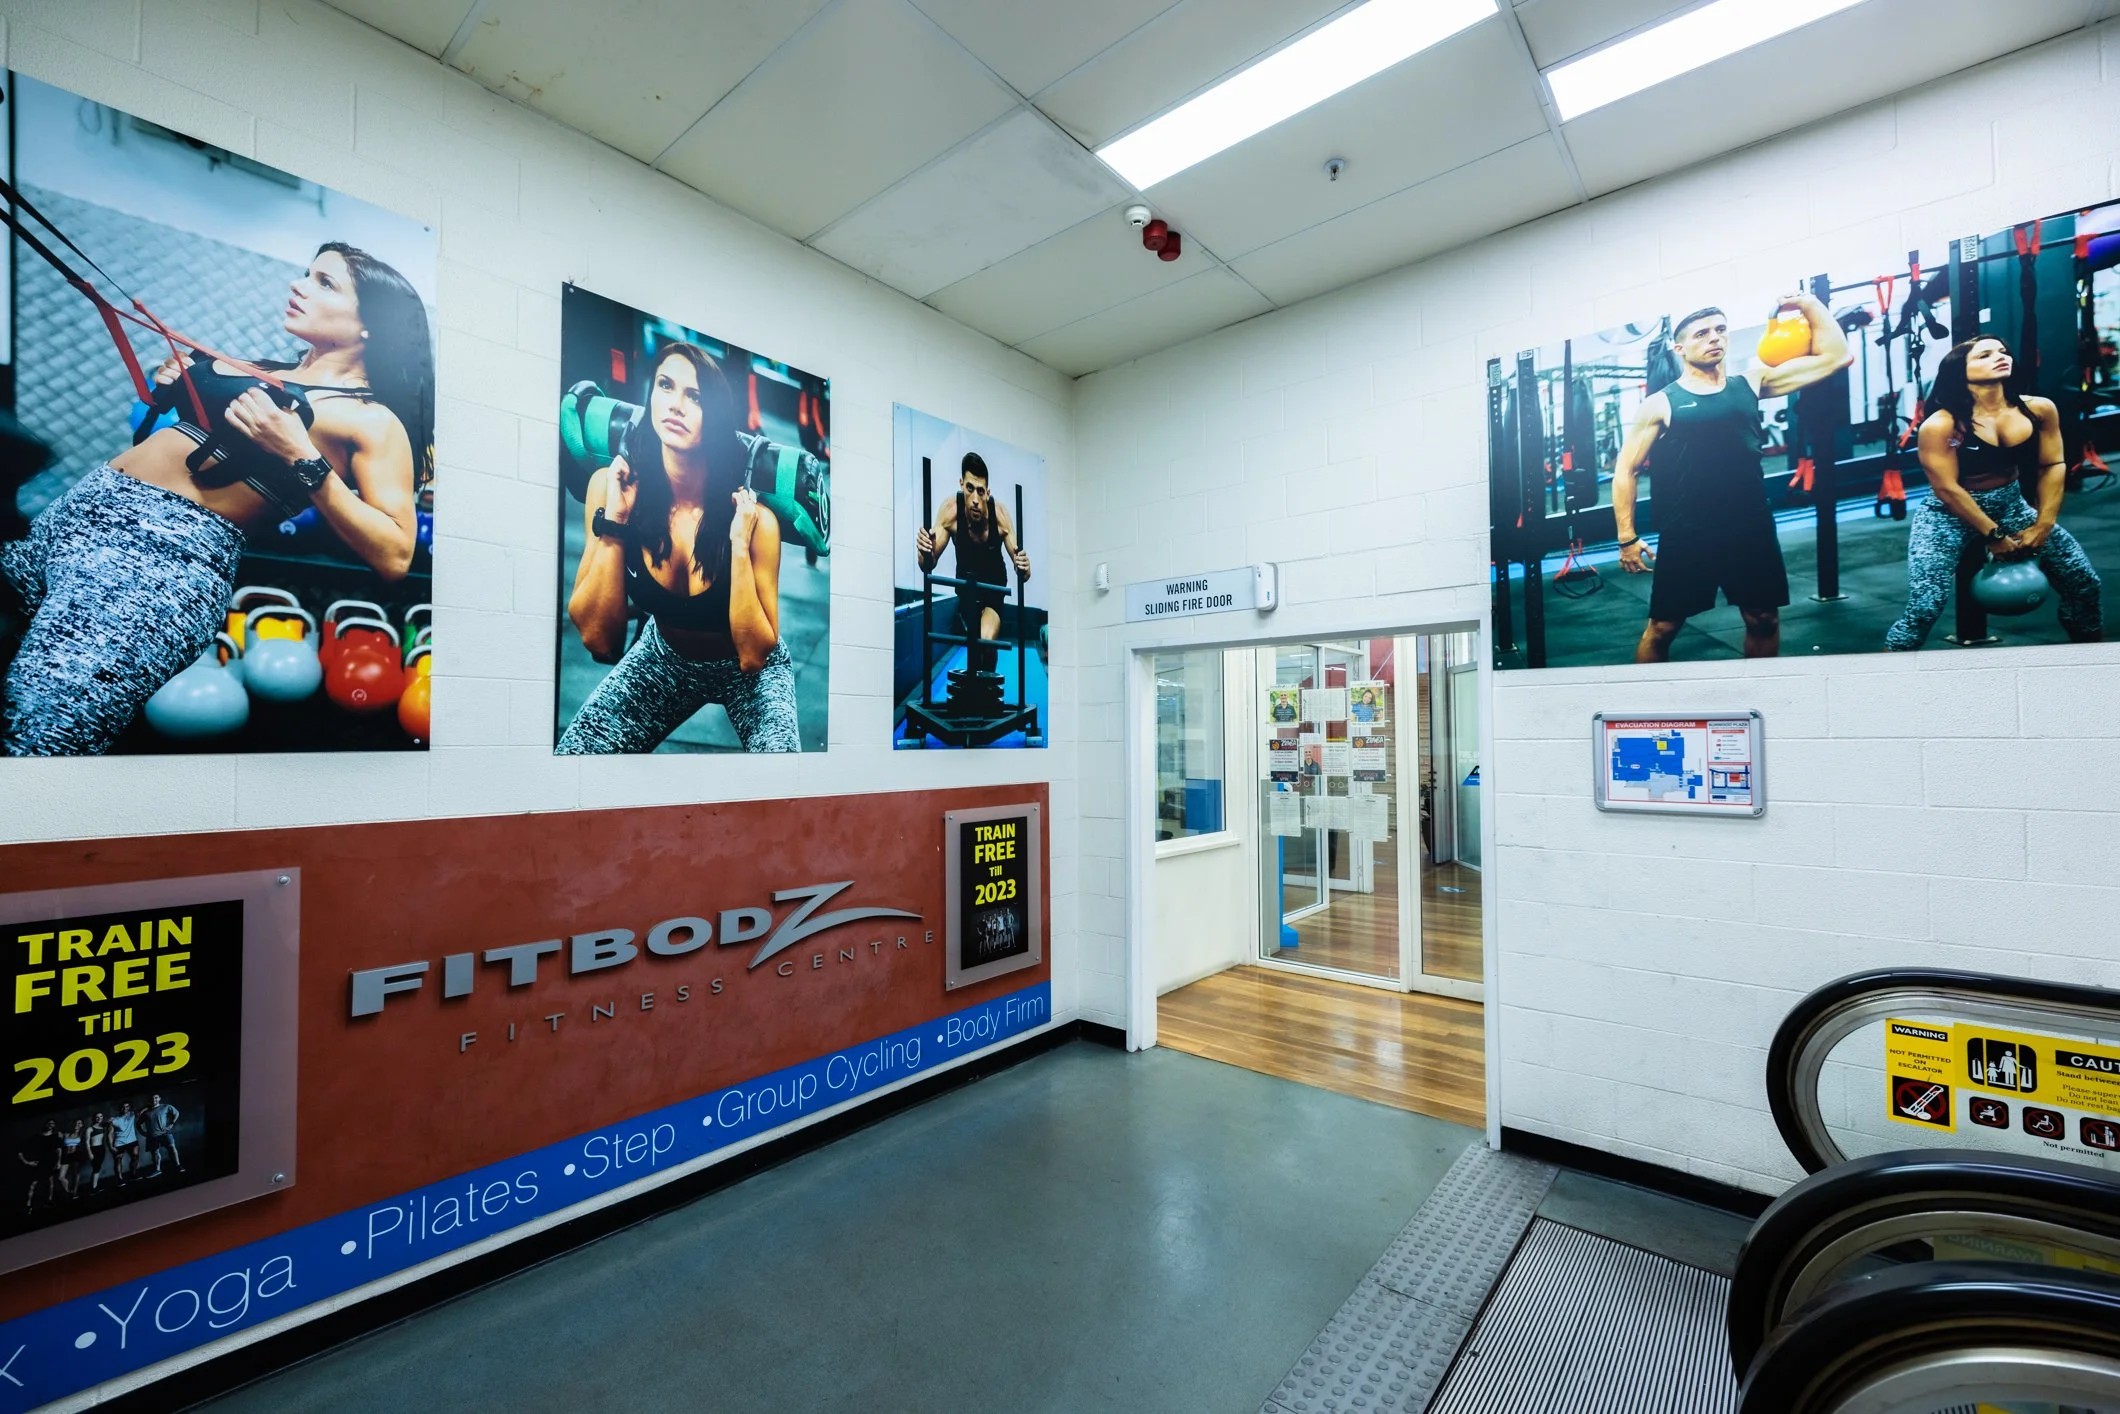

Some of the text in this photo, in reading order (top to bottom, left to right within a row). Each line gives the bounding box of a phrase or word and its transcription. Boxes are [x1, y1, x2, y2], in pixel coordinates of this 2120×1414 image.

[1166, 579, 1208, 596] WARNING
[1145, 594, 1233, 615] SLIDING FIRE DOOR
[1615, 721, 1660, 729] EVACUATION
[975, 823, 1016, 842] TRAIN
[975, 840, 1016, 864] FREE
[989, 865, 1003, 877] Till
[975, 878, 1017, 905] 2023
[17, 916, 193, 965] TRAIN
[350, 880, 924, 1018] FITBODZ
[14, 951, 191, 1014] FREE
[459, 930, 934, 1053] FITNESS CENTRE
[78, 1008, 133, 1036] Till
[946, 994, 1045, 1048] Body Firm
[1894, 1026, 1946, 1040] WARNING
[12, 1031, 191, 1105] 2023
[1898, 1061, 1943, 1074] ESCALATOR
[1908, 1051, 1952, 1064] PERMITTED
[717, 1034, 922, 1130] Group Cycling
[2056, 1070, 2082, 1080] Stand
[2062, 1084, 2091, 1093] Please
[2069, 1091, 2081, 1099] Do
[2100, 1097, 2119, 1106] lean
[2056, 1095, 2069, 1103] Do
[2070, 1098, 2084, 1106] not
[2087, 1102, 2104, 1110] rest
[582, 1122, 675, 1180] Step
[2043, 1140, 2105, 1159] Not permitted
[366, 1170, 539, 1260] Pilates
[98, 1255, 297, 1349] Yoga
